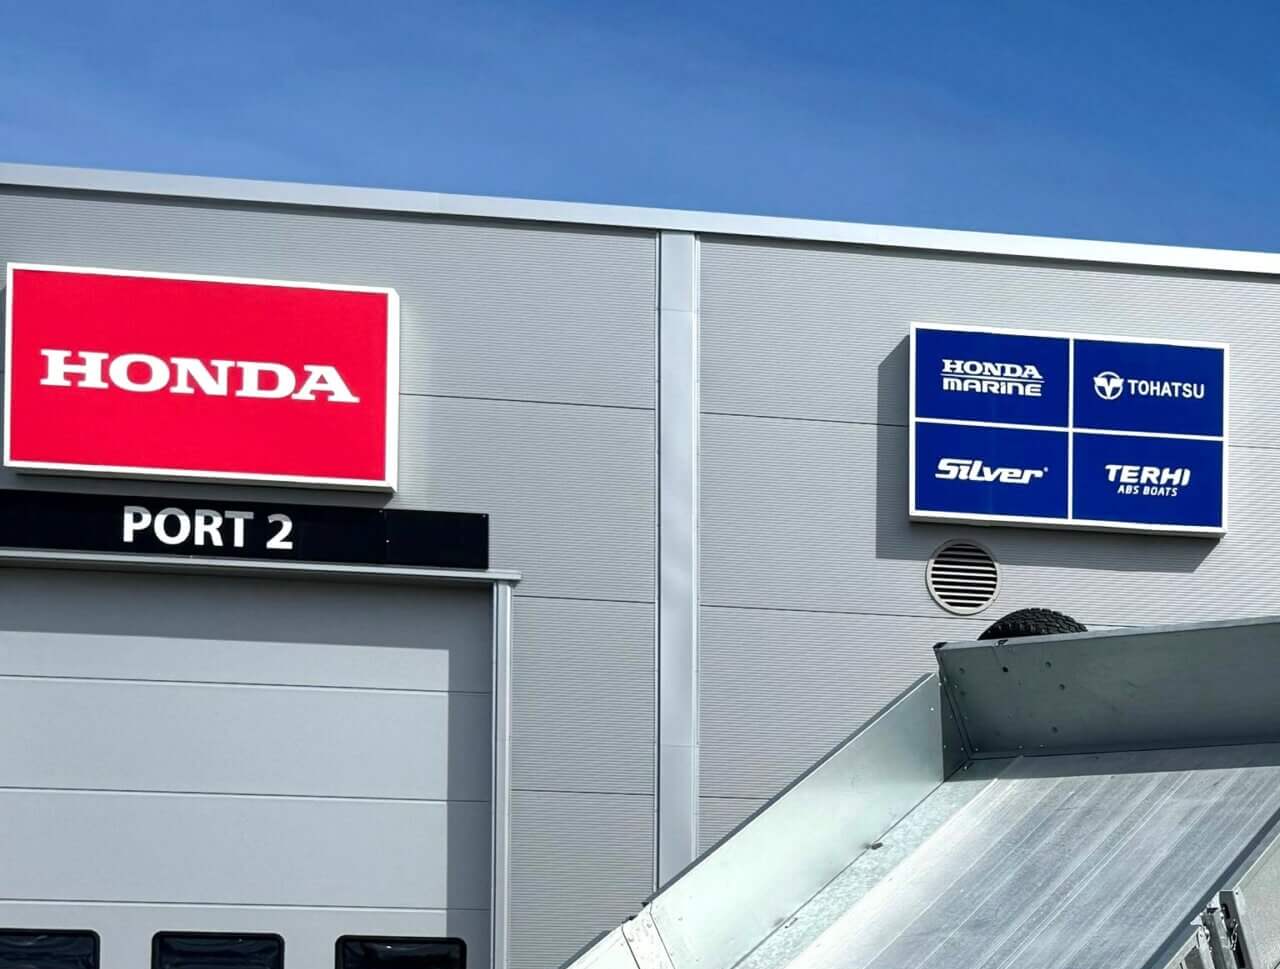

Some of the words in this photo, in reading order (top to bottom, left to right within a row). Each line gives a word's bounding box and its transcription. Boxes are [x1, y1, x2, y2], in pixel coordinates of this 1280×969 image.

[40, 349, 360, 403] HONDA
[942, 359, 1043, 379] HONDA
[943, 378, 1042, 397] MARINE
[1127, 379, 1205, 399] TOHATSU
[935, 458, 1044, 484] Silver
[1105, 464, 1191, 486] TERHI
[1117, 485, 1140, 495] ABS
[1143, 486, 1178, 497] BOATS
[123, 506, 254, 548] PORT
[266, 514, 294, 550] 2
